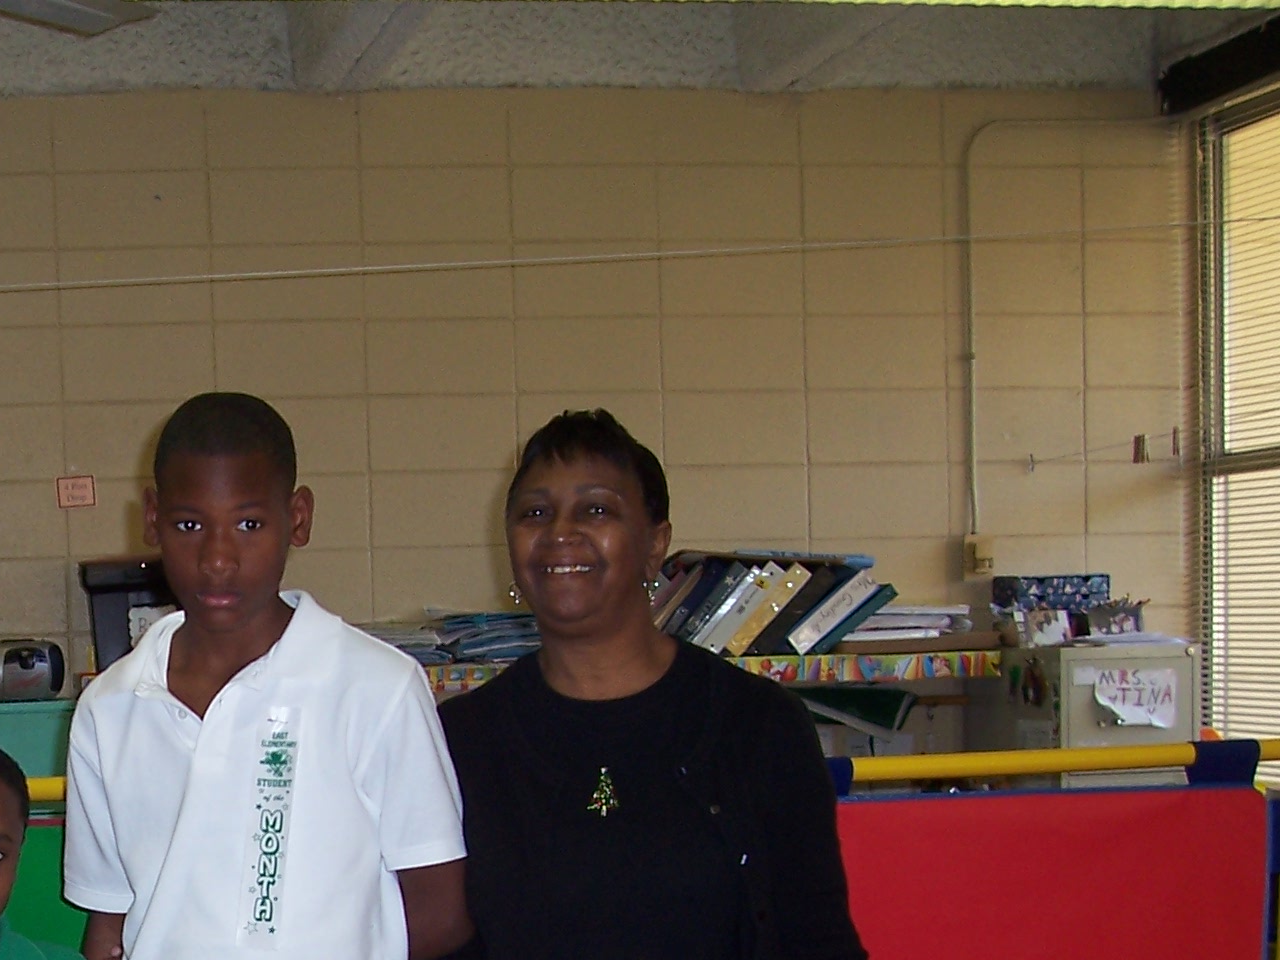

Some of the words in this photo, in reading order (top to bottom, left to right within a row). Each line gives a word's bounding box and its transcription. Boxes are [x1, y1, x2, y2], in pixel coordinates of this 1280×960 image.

[1116, 684, 1172, 707] TINA
[272, 732, 288, 740] EAST
[256, 778, 292, 787] STUDENT
[253, 809, 283, 922] MONTH
